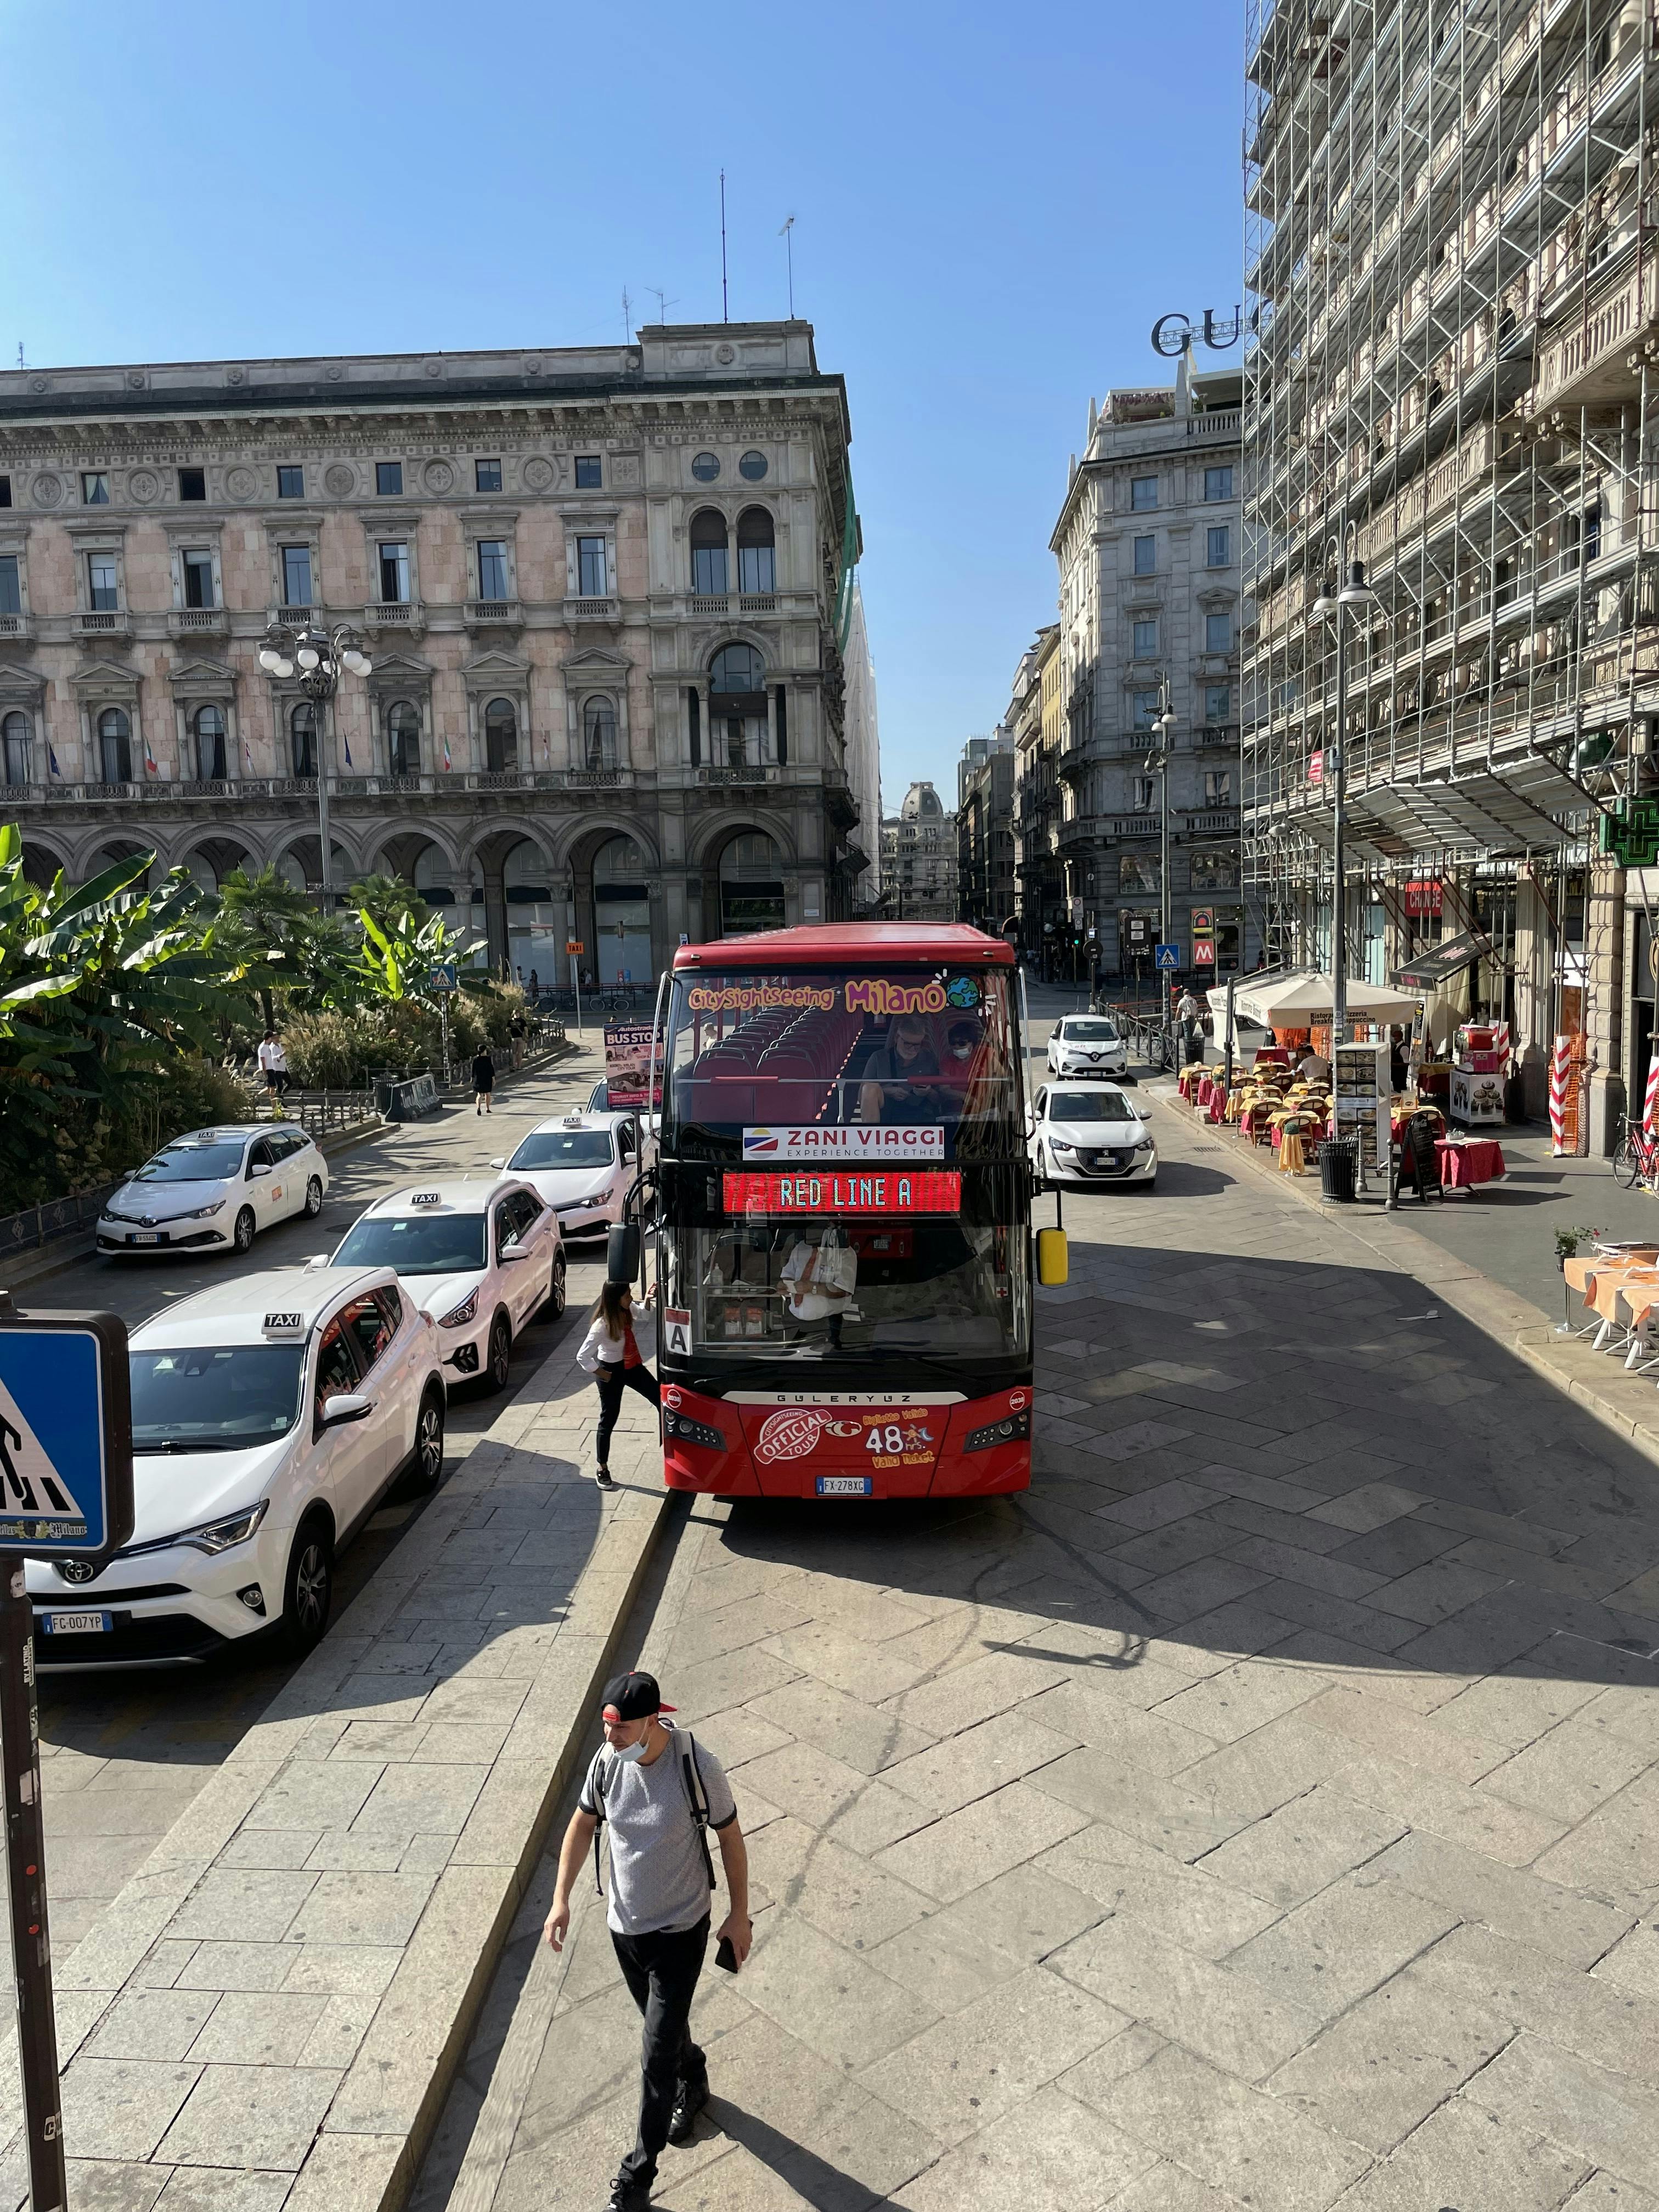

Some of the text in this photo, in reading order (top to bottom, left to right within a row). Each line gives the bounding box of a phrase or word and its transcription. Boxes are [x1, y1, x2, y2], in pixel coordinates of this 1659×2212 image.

[1196, 945, 1212, 960] M
[845, 979, 947, 1014] Milano
[607, 1034, 630, 1045] BUS
[788, 1130, 944, 1146] ZANI VIAGGI
[413, 1194, 437, 1203] TAXI
[781, 1179, 911, 1206] RED LINE A
[267, 1314, 299, 1326] TAXI
[670, 1325, 687, 1352] A
[765, 1411, 803, 1436] CITYSIGHTSEEING
[901, 1408, 928, 1420] Valido
[763, 1413, 827, 1457] OFFICIAL
[788, 1434, 817, 1455] TOUR
[866, 1426, 904, 1454] 48
[872, 1451, 935, 1469] Valid Ticket
